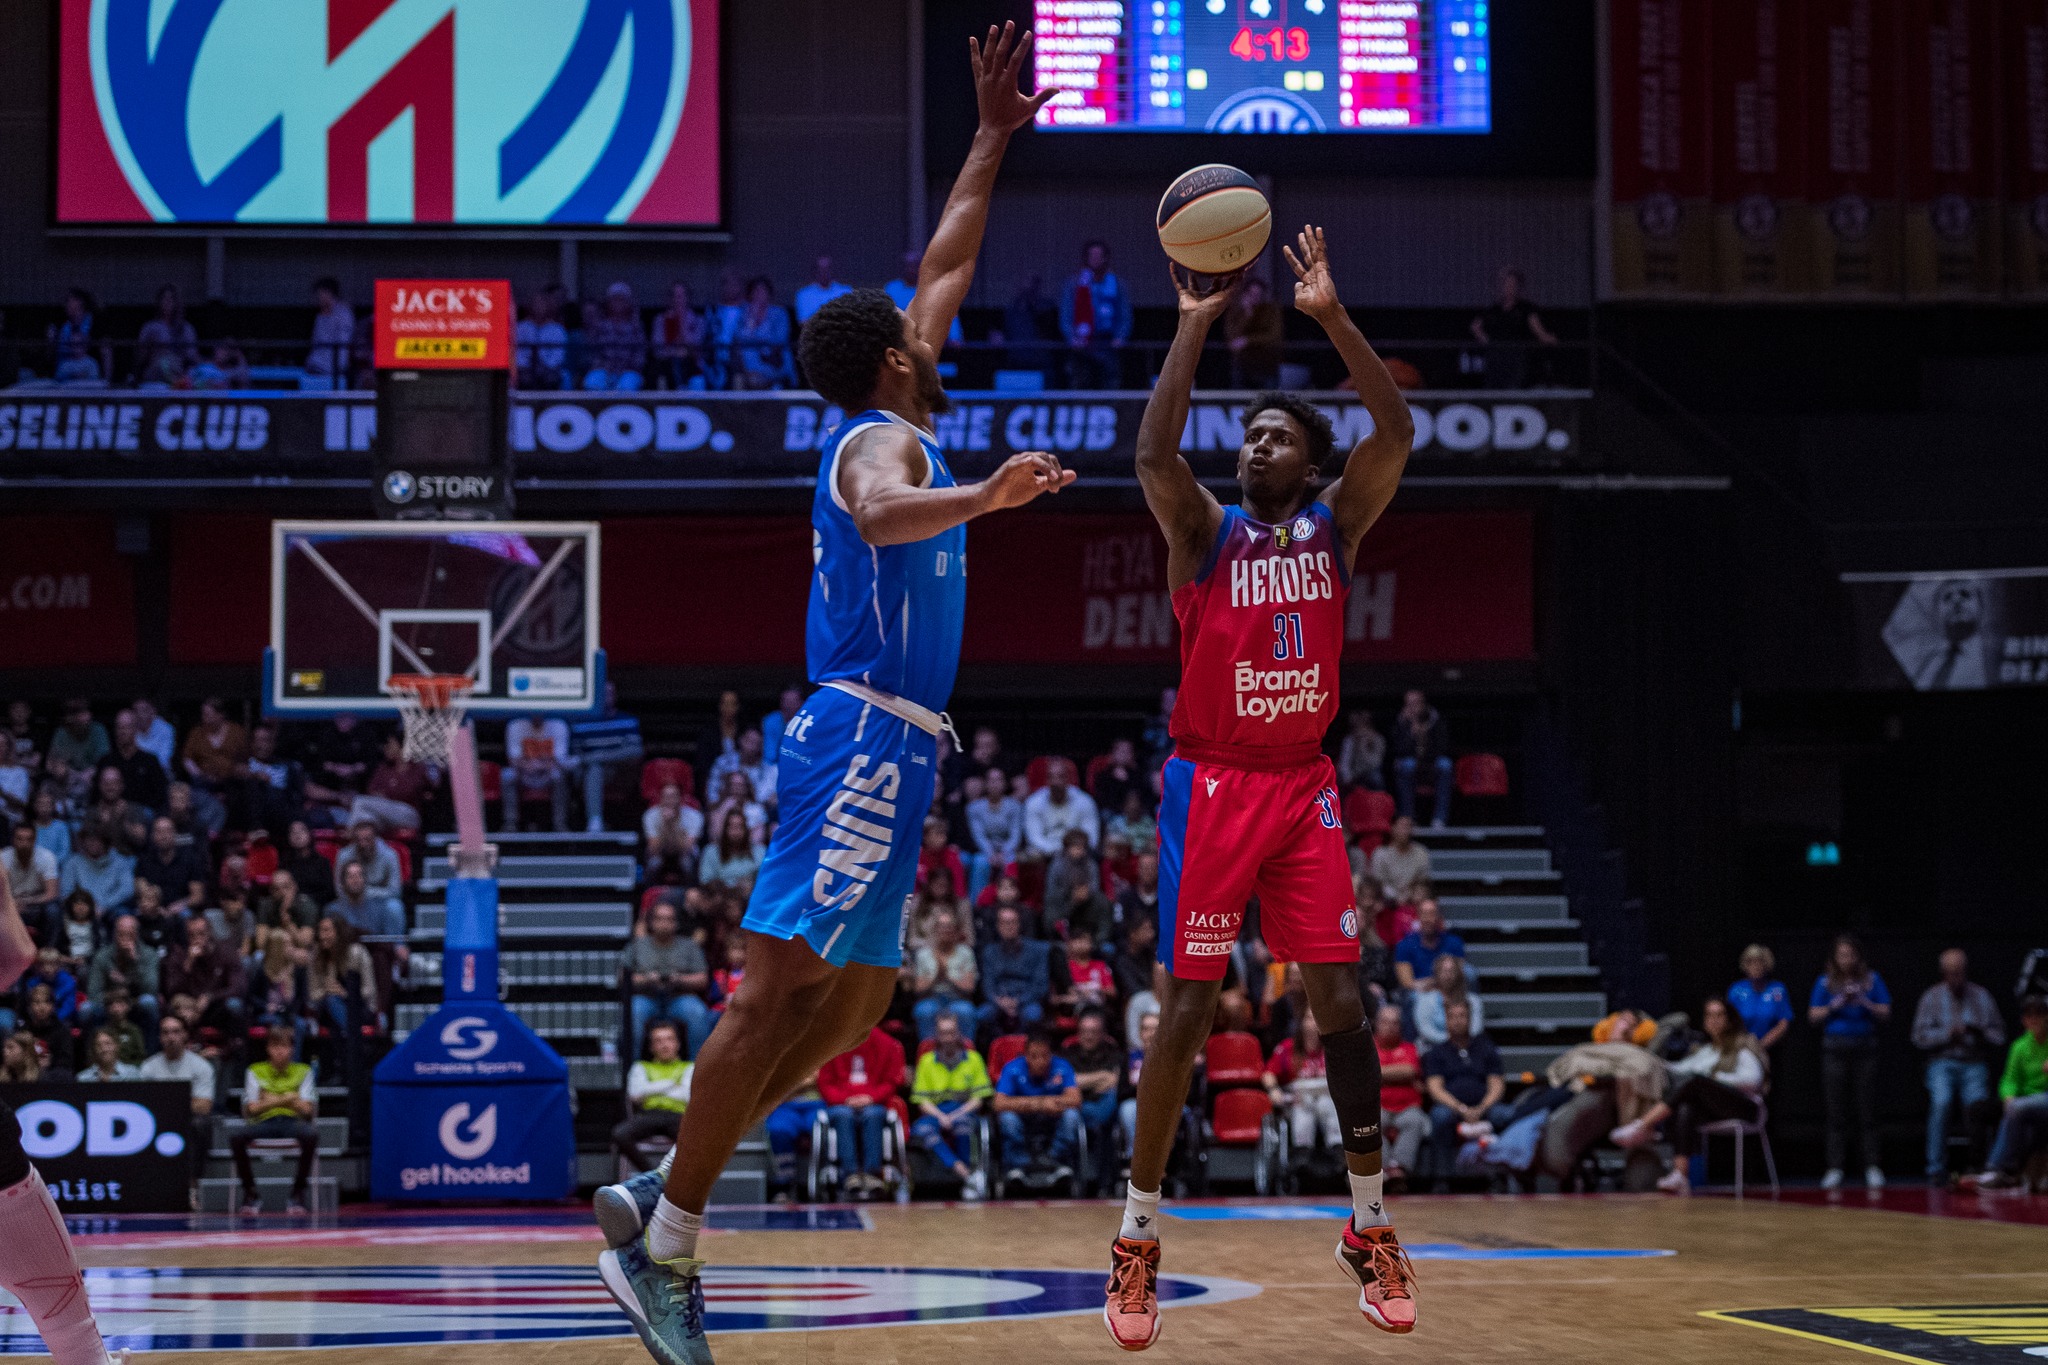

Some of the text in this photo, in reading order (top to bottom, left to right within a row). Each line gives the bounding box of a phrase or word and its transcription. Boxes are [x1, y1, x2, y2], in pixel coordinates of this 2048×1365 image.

[1229, 26, 1310, 61] 4:13
[391, 288, 493, 313] JACK'S
[155, 404, 270, 451] CLUB
[1004, 404, 1118, 452] CLUB
[417, 475, 495, 499] STORY
[1231, 551, 1332, 608] HEROES
[1273, 612, 1304, 661] 31
[1235, 661, 1320, 693] Brand
[1236, 689, 1328, 723] Loyalty
[812, 754, 901, 911] SUNS
[1184, 931, 1213, 941] CASINO
[1213, 933, 1220, 941] &
[1186, 911, 1241, 928] JACK'S
[400, 1162, 530, 1190] get hooked
